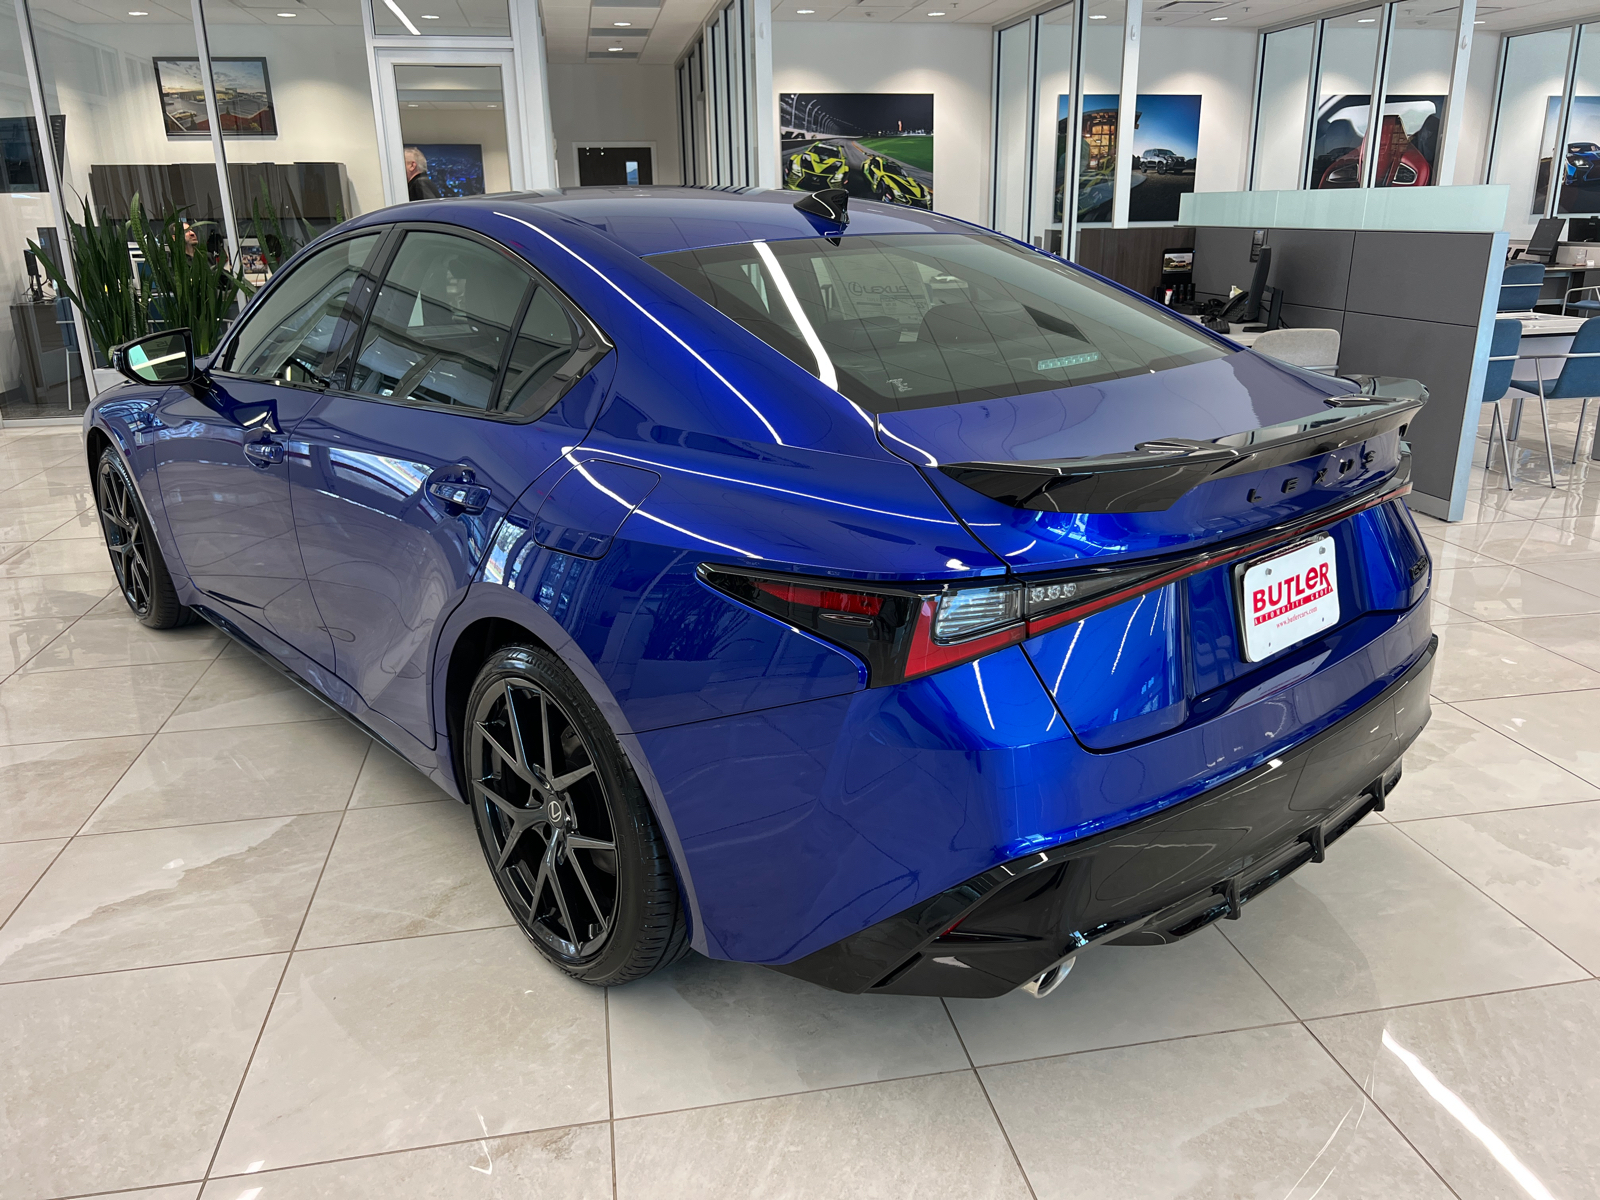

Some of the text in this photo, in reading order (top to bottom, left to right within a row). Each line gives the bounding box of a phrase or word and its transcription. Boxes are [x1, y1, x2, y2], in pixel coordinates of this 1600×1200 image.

[863, 285, 909, 294] LEXUS
[1247, 450, 1376, 503] LEXUS
[1254, 585, 1332, 625] AUTOMOTIVE GROUP
[1276, 606, 1318, 629] www.butlercars.com
